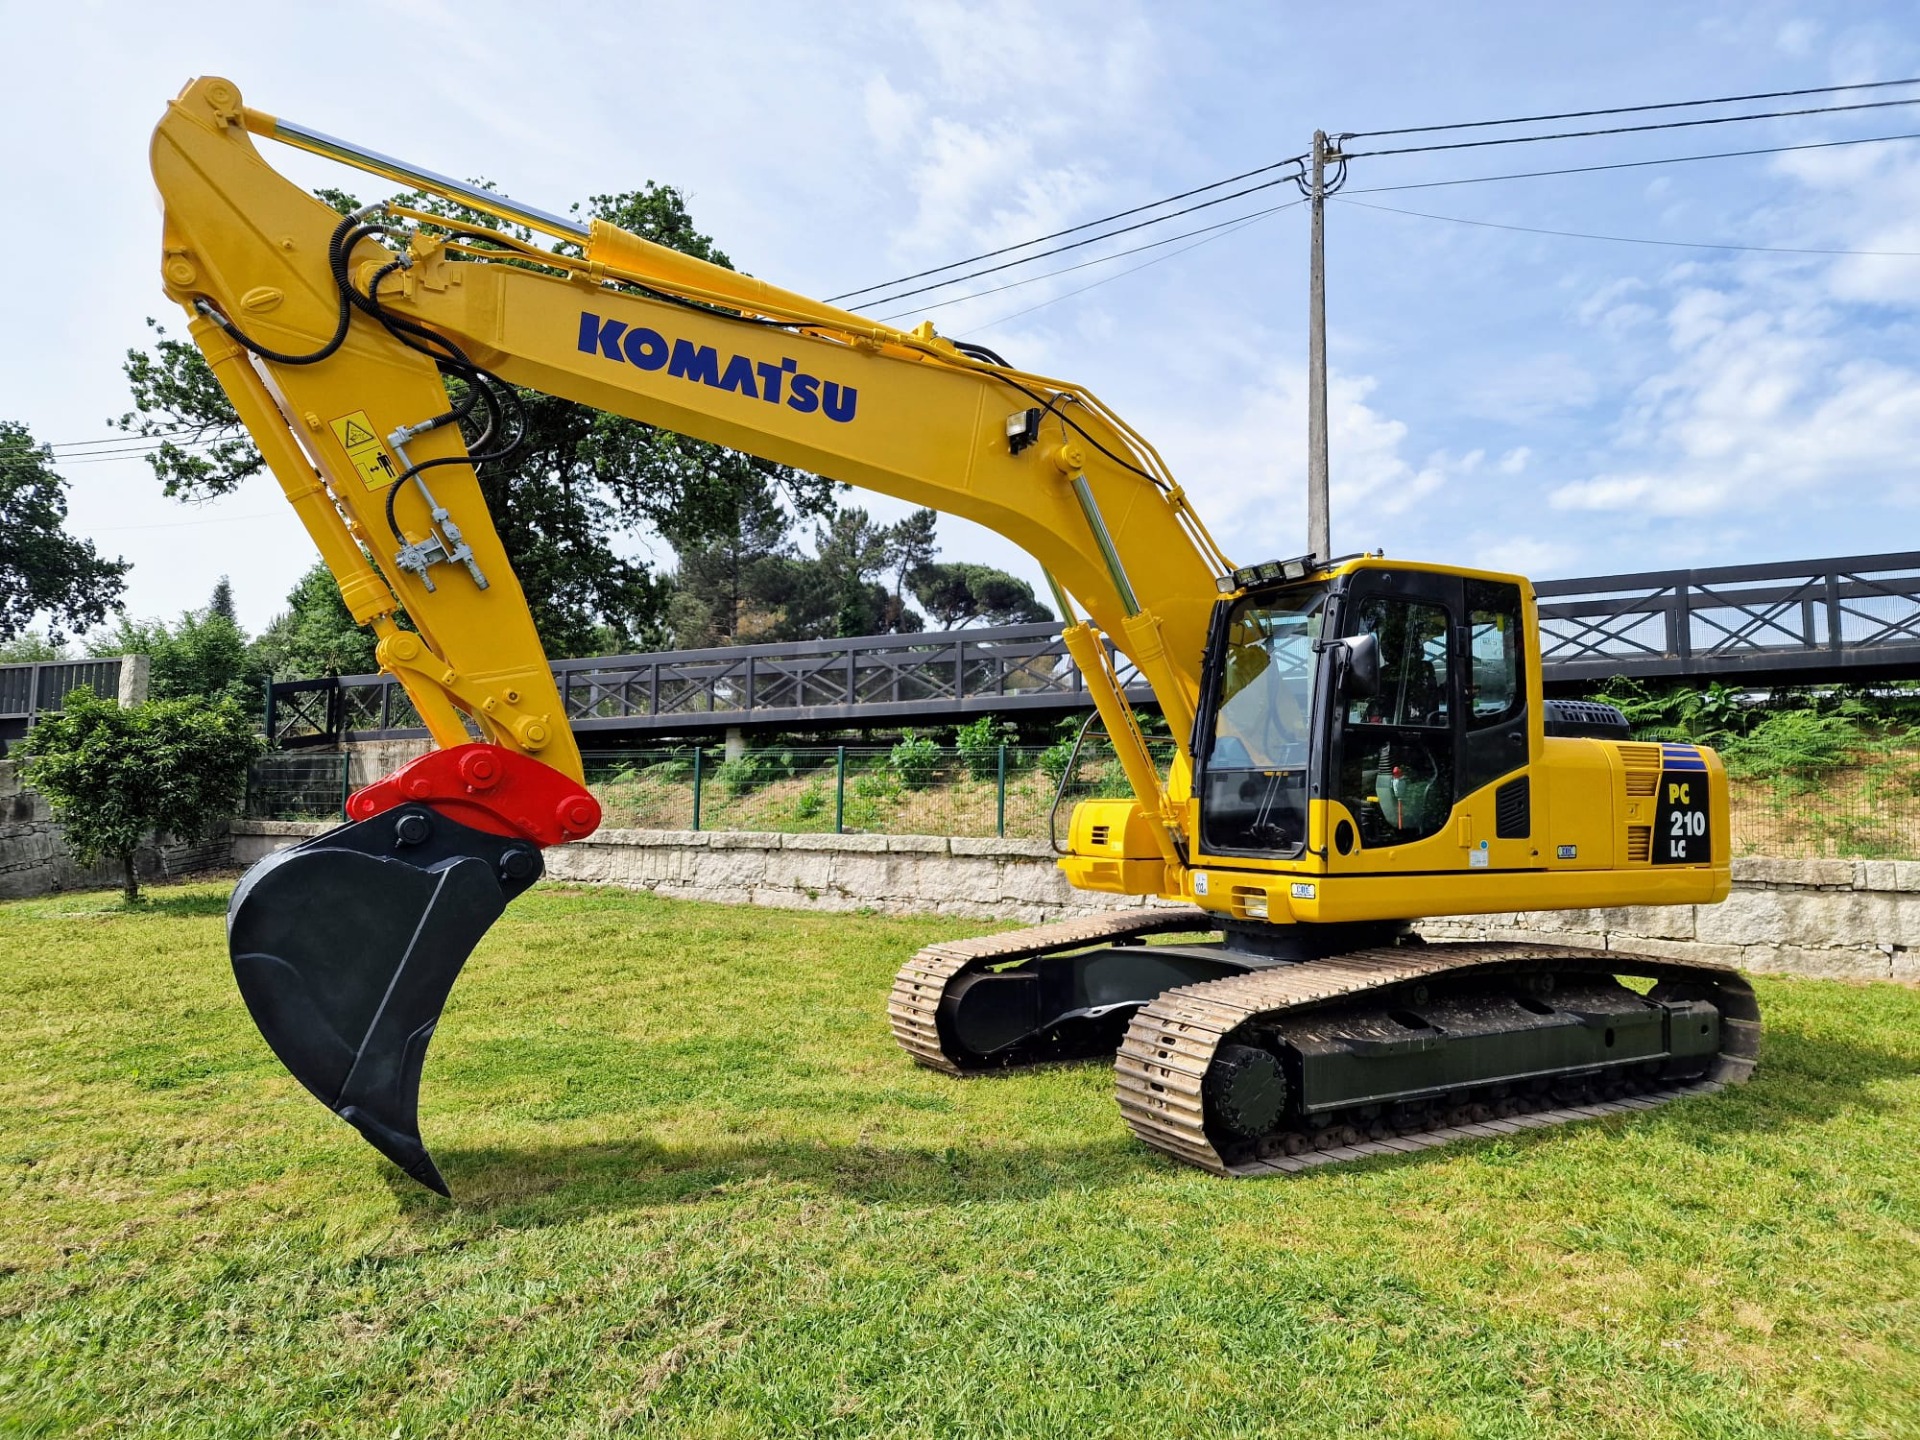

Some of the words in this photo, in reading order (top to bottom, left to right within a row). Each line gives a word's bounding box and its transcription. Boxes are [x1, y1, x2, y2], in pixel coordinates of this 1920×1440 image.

[578, 311, 857, 423] KOMATSU
[1668, 783, 1690, 804] PC
[1670, 811, 1705, 836] 210
[1670, 840, 1686, 857] LC
